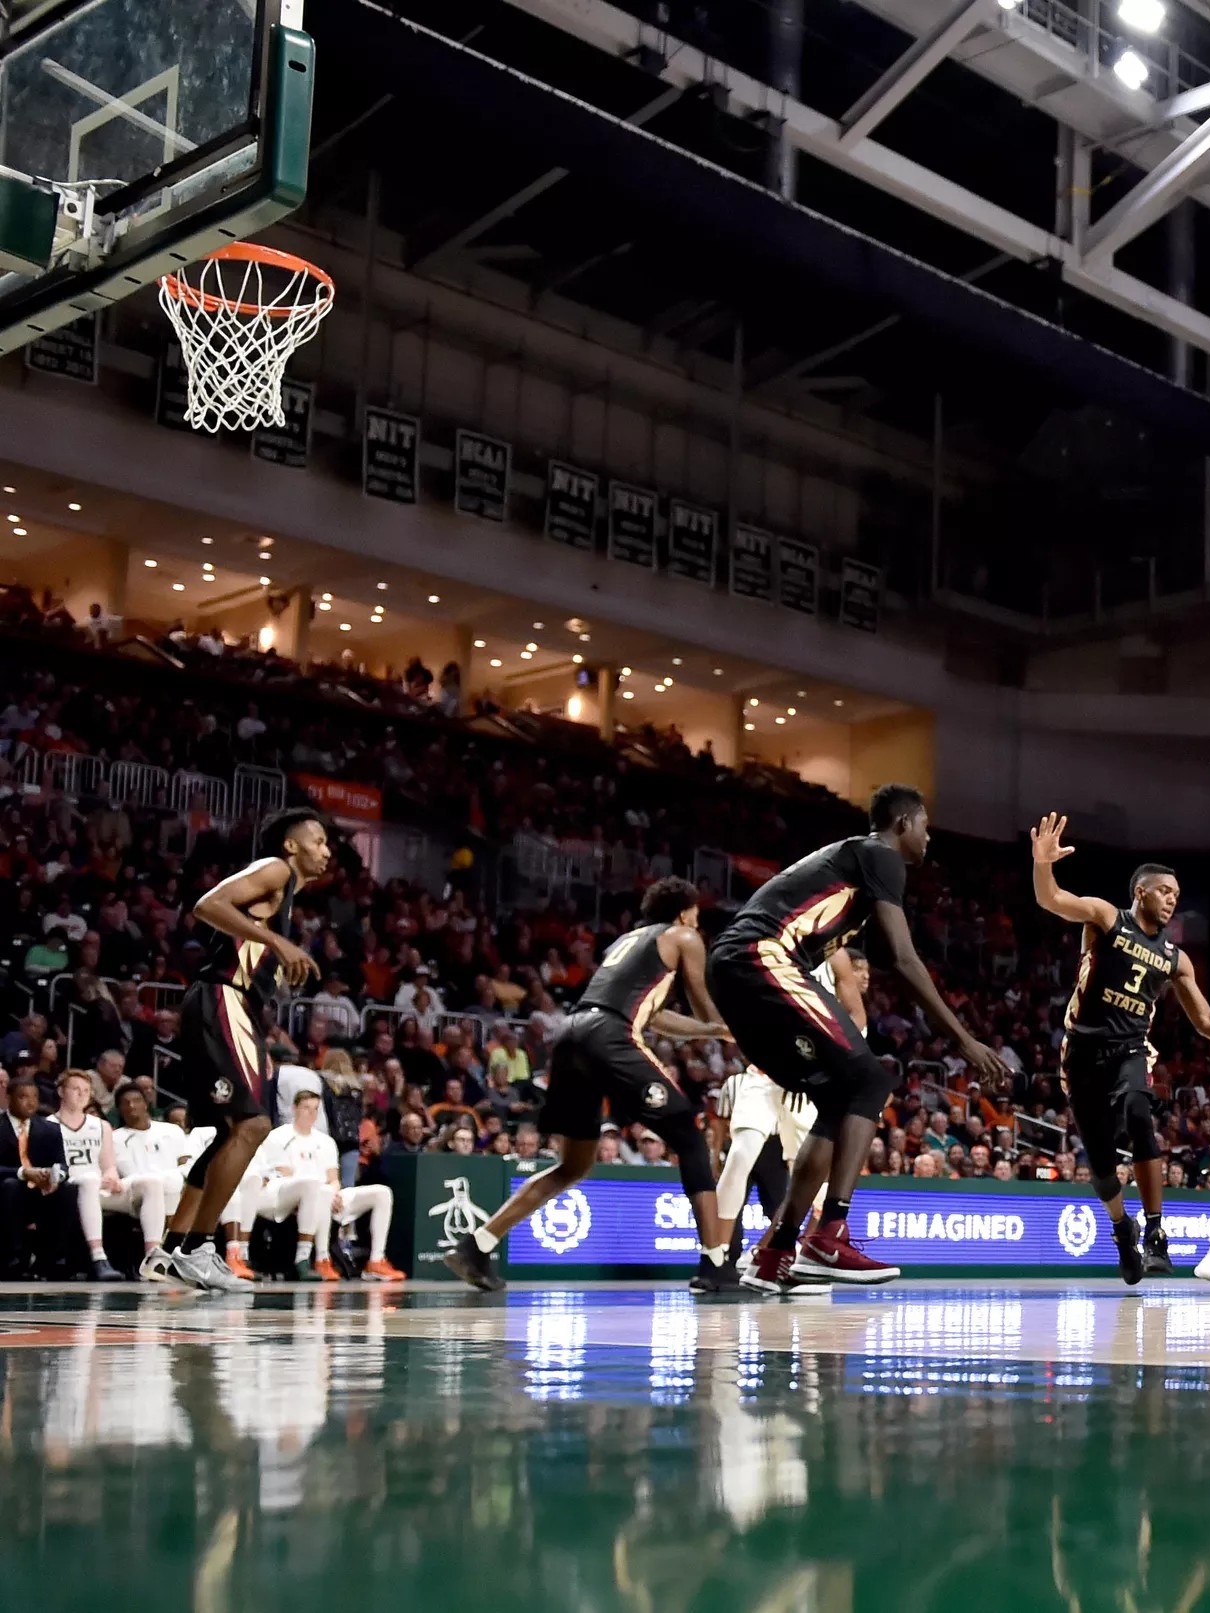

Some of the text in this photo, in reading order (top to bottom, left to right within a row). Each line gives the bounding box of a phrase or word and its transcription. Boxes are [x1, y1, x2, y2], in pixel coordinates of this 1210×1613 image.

[368, 415, 415, 449] NIT
[552, 468, 594, 501] NIT
[614, 489, 652, 518] NIT
[1112, 934, 1172, 975] FLORIDA
[1123, 963, 1147, 994] 3
[1102, 987, 1146, 1016] STATE
[68, 1148, 92, 1165] 21
